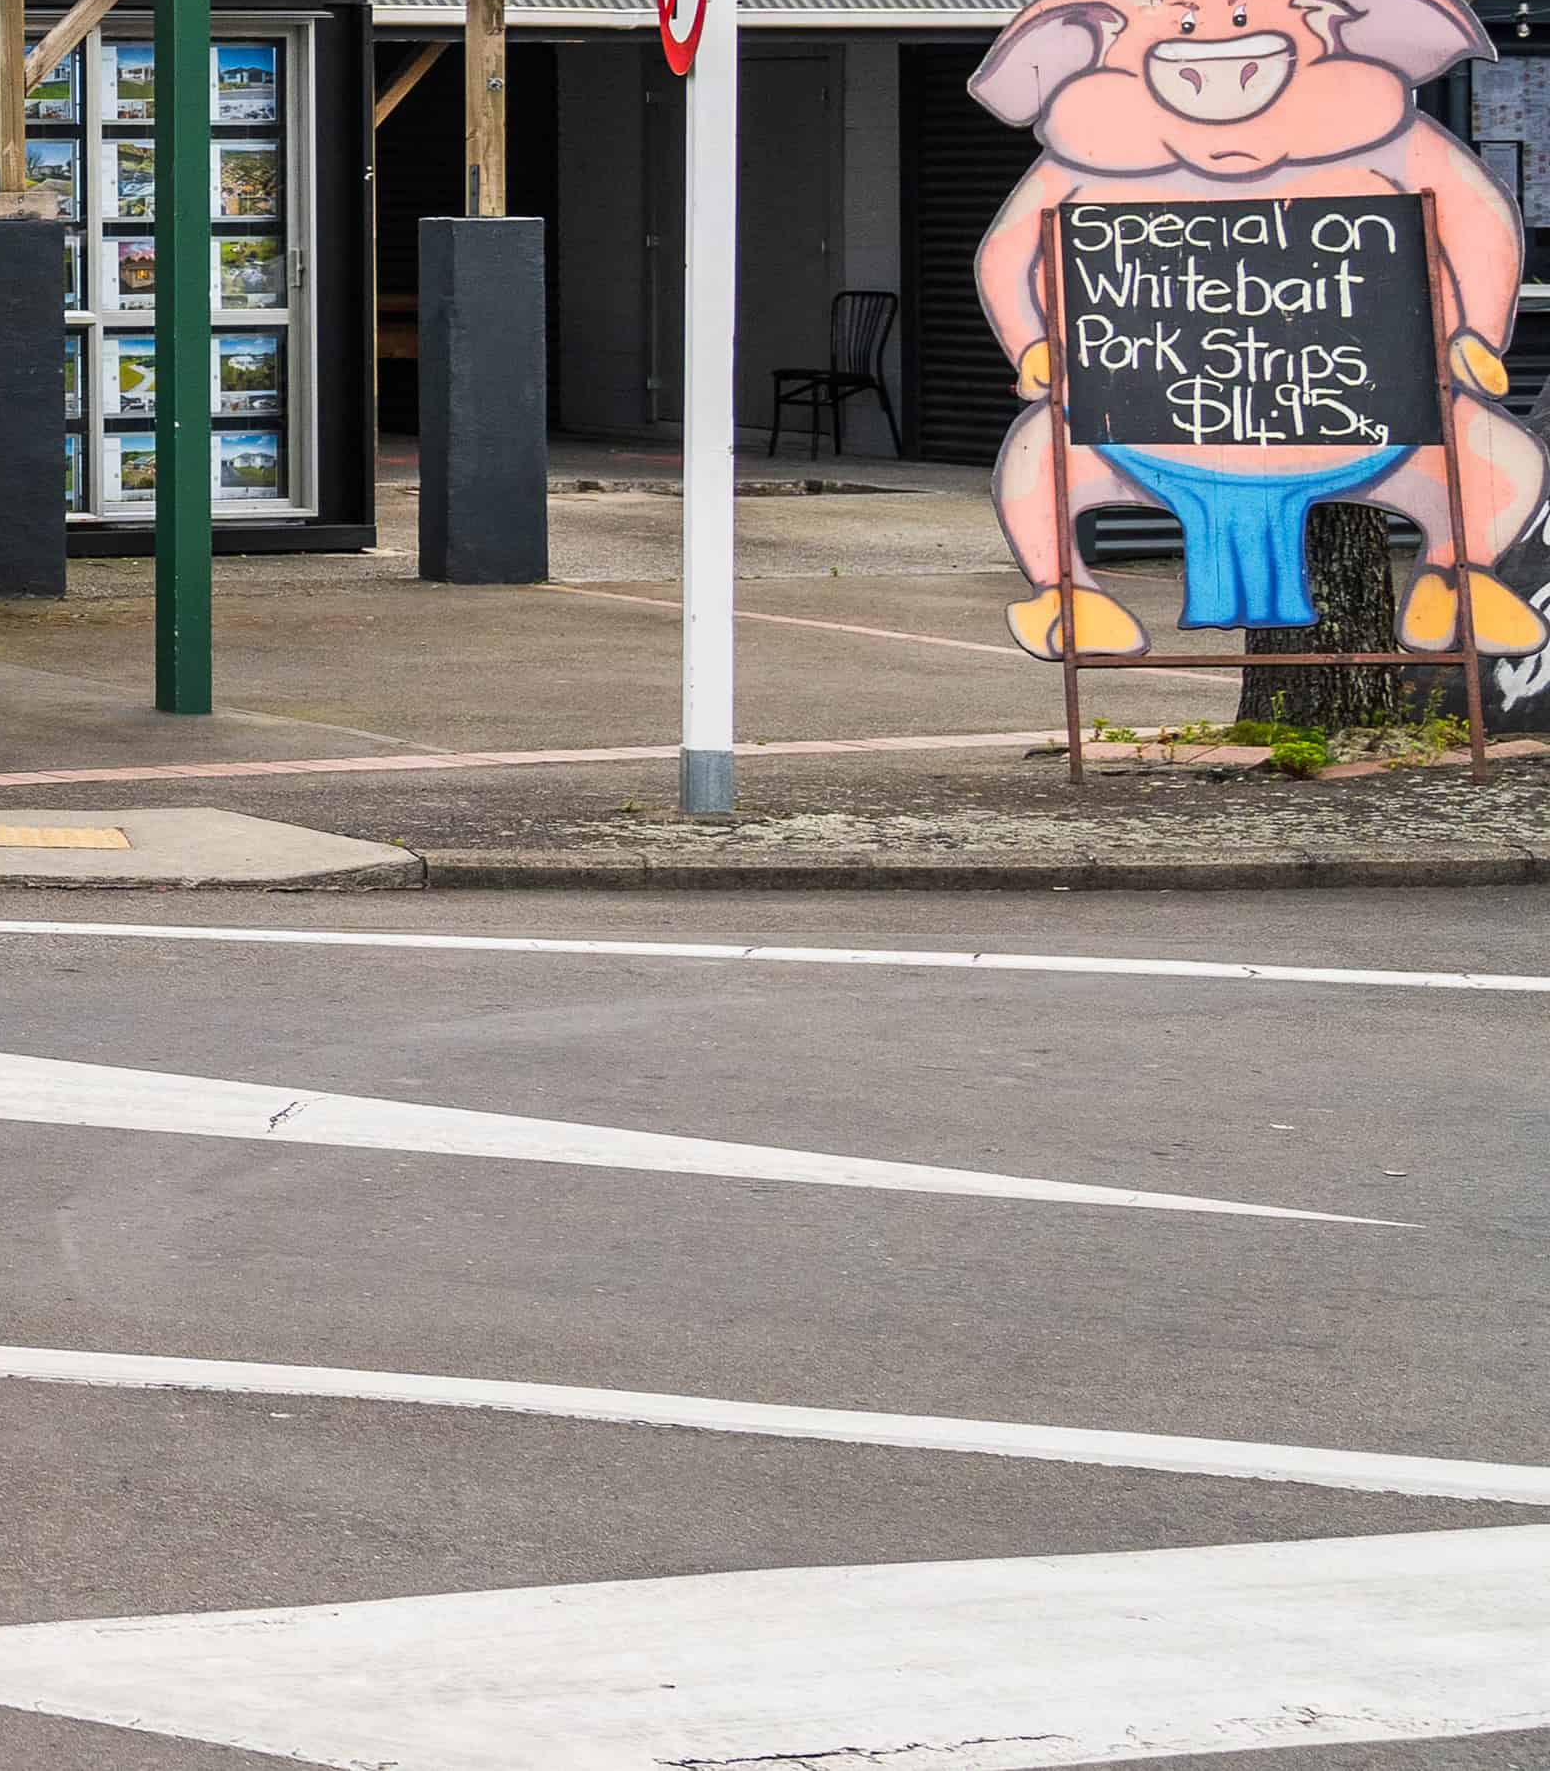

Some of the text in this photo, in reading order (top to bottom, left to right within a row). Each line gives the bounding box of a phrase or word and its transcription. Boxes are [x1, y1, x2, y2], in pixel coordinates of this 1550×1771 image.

[1071, 201, 1396, 273] Special on
[1075, 255, 1365, 317] Whitebait
[1076, 314, 1369, 406] Pork Strips
